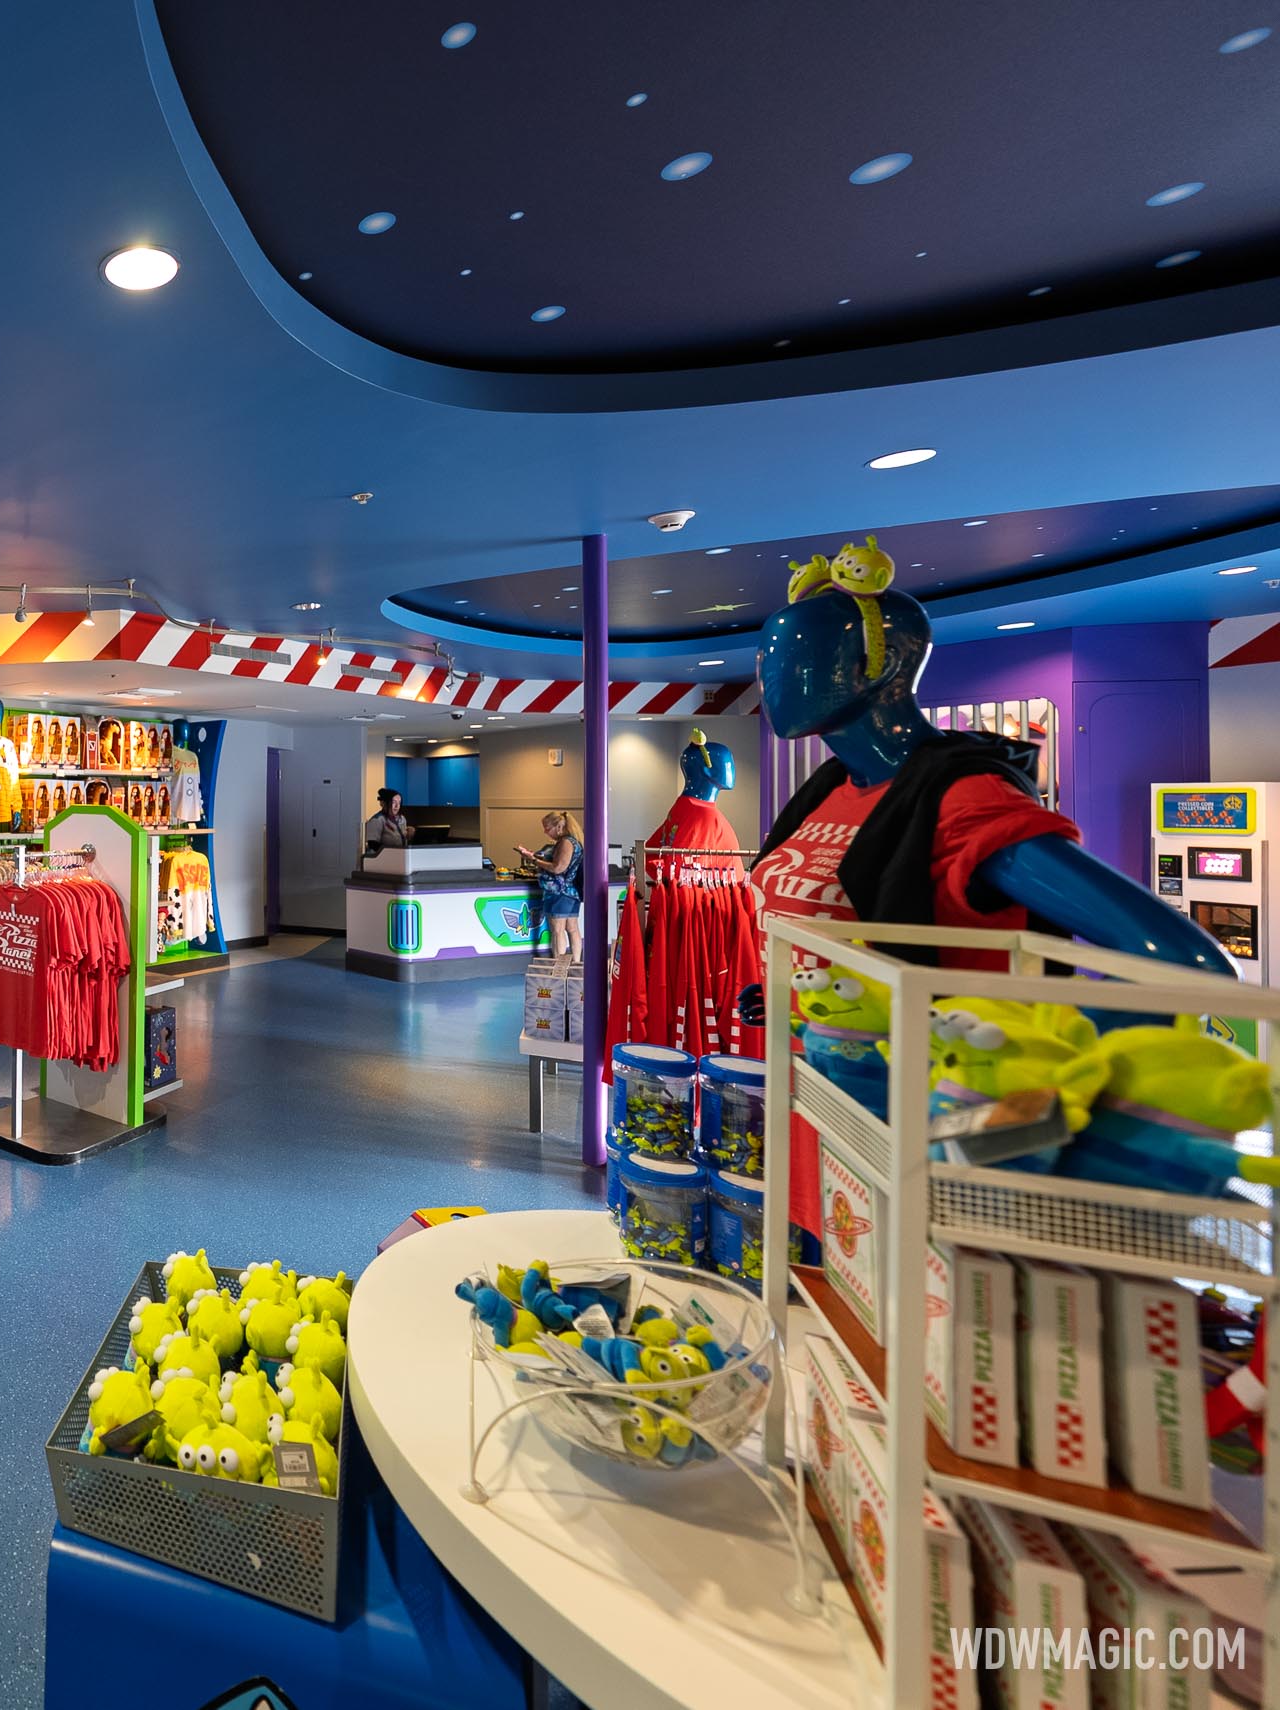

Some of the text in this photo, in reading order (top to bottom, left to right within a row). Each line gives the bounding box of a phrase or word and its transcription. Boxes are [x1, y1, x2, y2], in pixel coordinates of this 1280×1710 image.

[4, 923, 38, 948] Pizza
[974, 1329, 993, 1382] PIZZA
[1058, 1345, 1078, 1399] PIZZA
[1155, 1369, 1180, 1427] PIZZA
[930, 1601, 951, 1654] PIZZA
